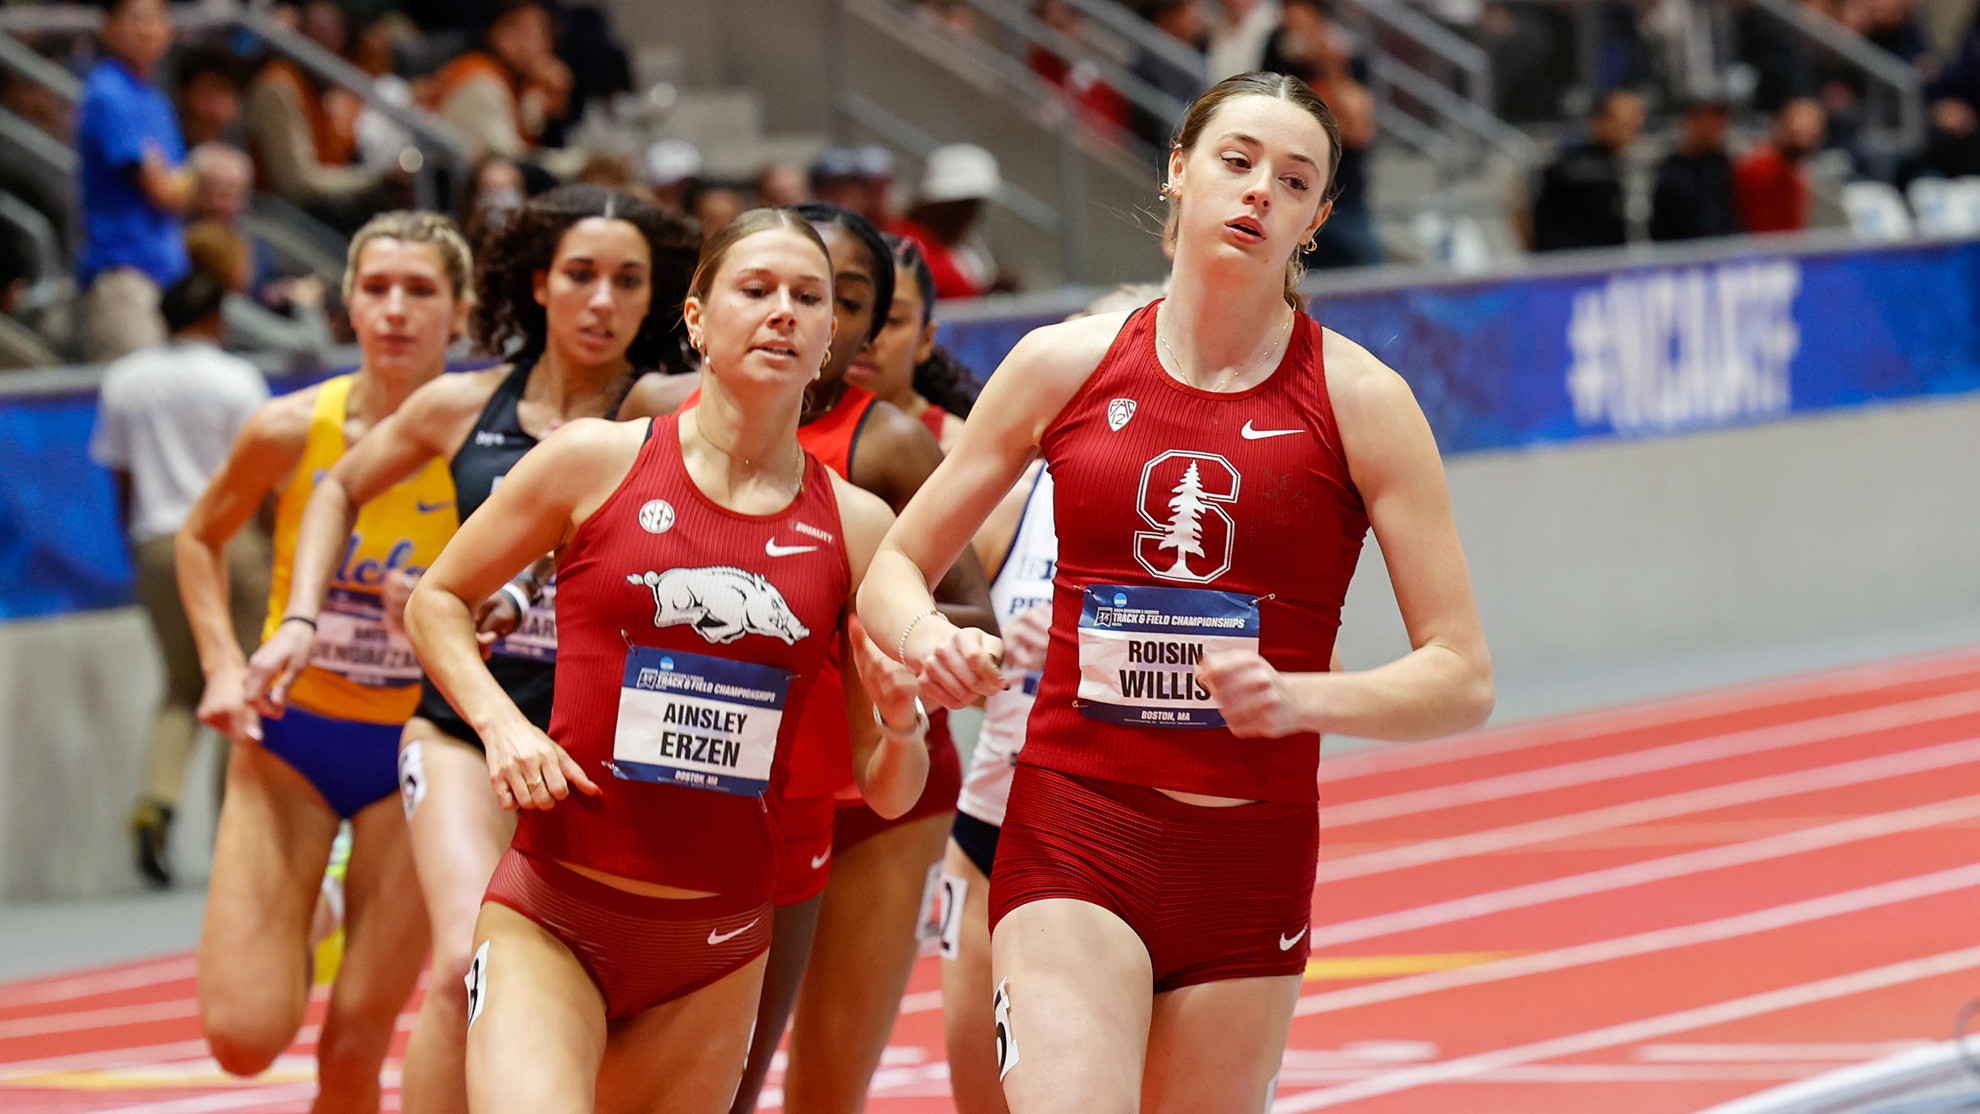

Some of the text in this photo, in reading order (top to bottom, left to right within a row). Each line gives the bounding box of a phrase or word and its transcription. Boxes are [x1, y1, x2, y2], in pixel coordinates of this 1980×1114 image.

[1112, 612, 1246, 629] TRACK & FIELD CHAMPIONSHIPS
[1128, 640, 1203, 666] ROISIN
[656, 673, 684, 690] TRACK
[691, 678, 714, 694] FIELD
[713, 683, 776, 703] CHAMPIONSHIPS
[663, 702, 748, 735] AINSLEY
[1141, 710, 1175, 722] BOSTON,
[1176, 711, 1191, 722] MA
[660, 732, 741, 768] ERZEN
